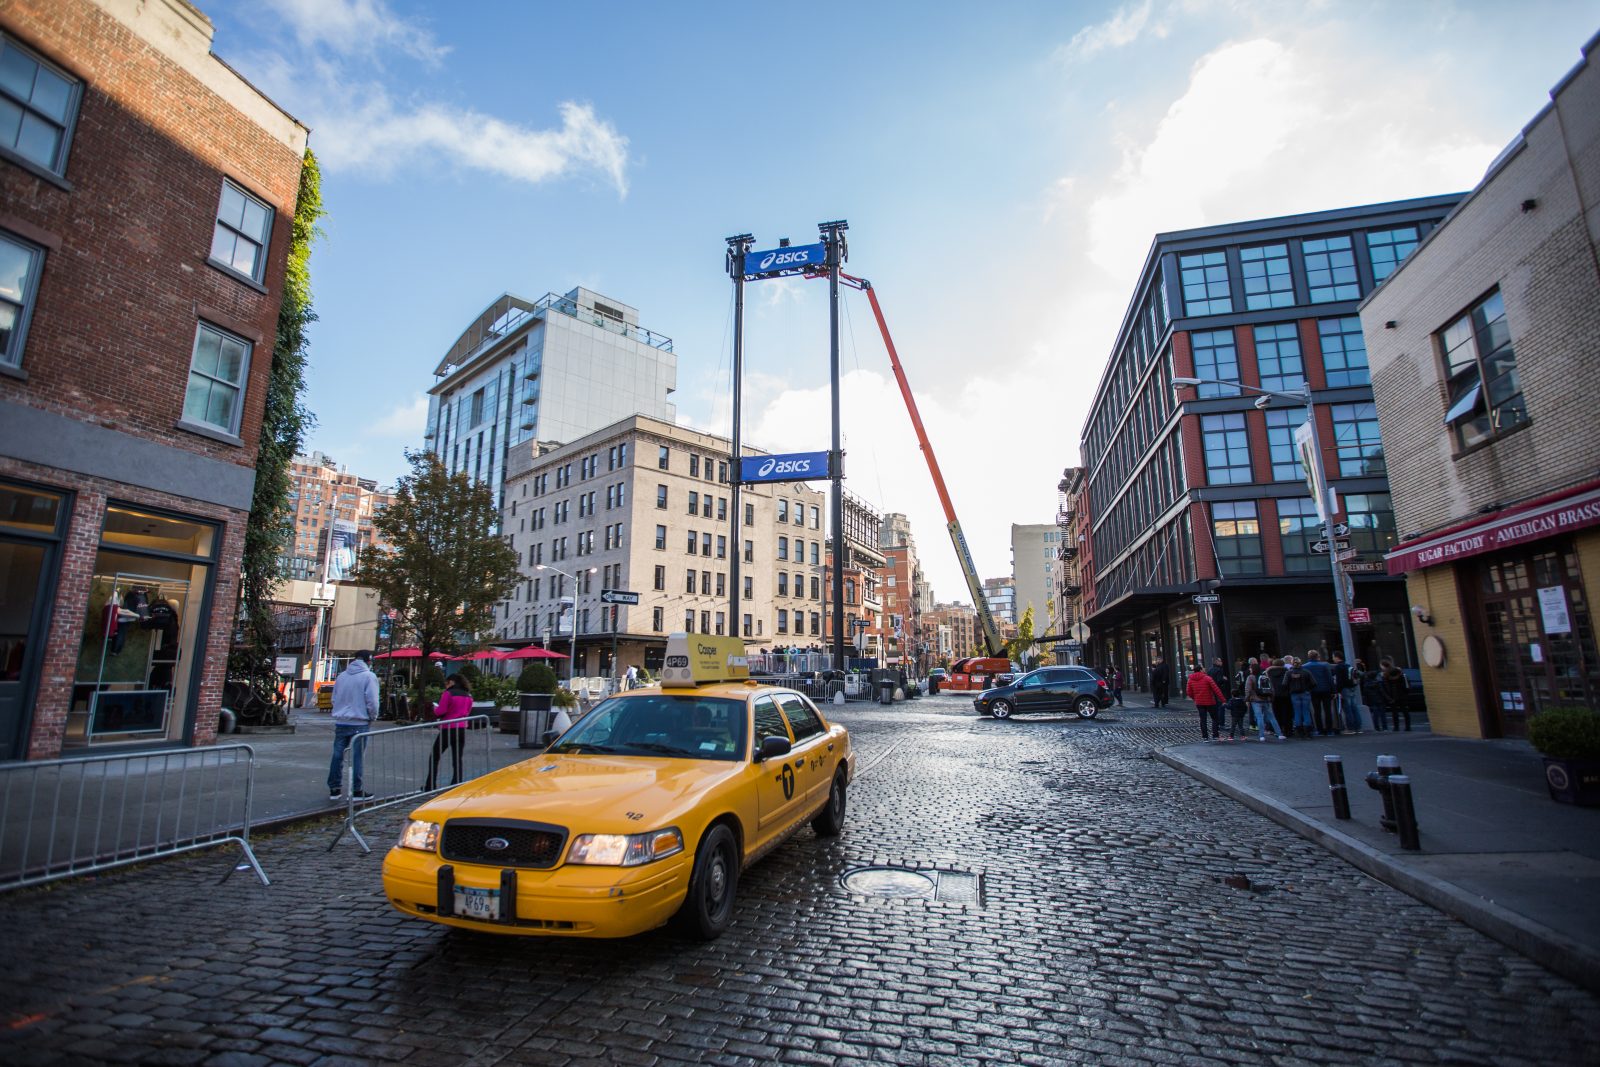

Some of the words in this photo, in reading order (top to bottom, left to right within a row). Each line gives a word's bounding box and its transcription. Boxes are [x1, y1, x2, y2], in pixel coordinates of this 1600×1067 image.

[776, 250, 809, 264] asics
[775, 460, 811, 474] asics
[1418, 548, 1443, 564] SUGAR
[1444, 534, 1485, 556] FACTORY
[1496, 514, 1557, 542] AMERICAN
[1343, 563, 1374, 572] GREENWICH
[1376, 562, 1383, 570] ST
[666, 656, 688, 666] 4P69
